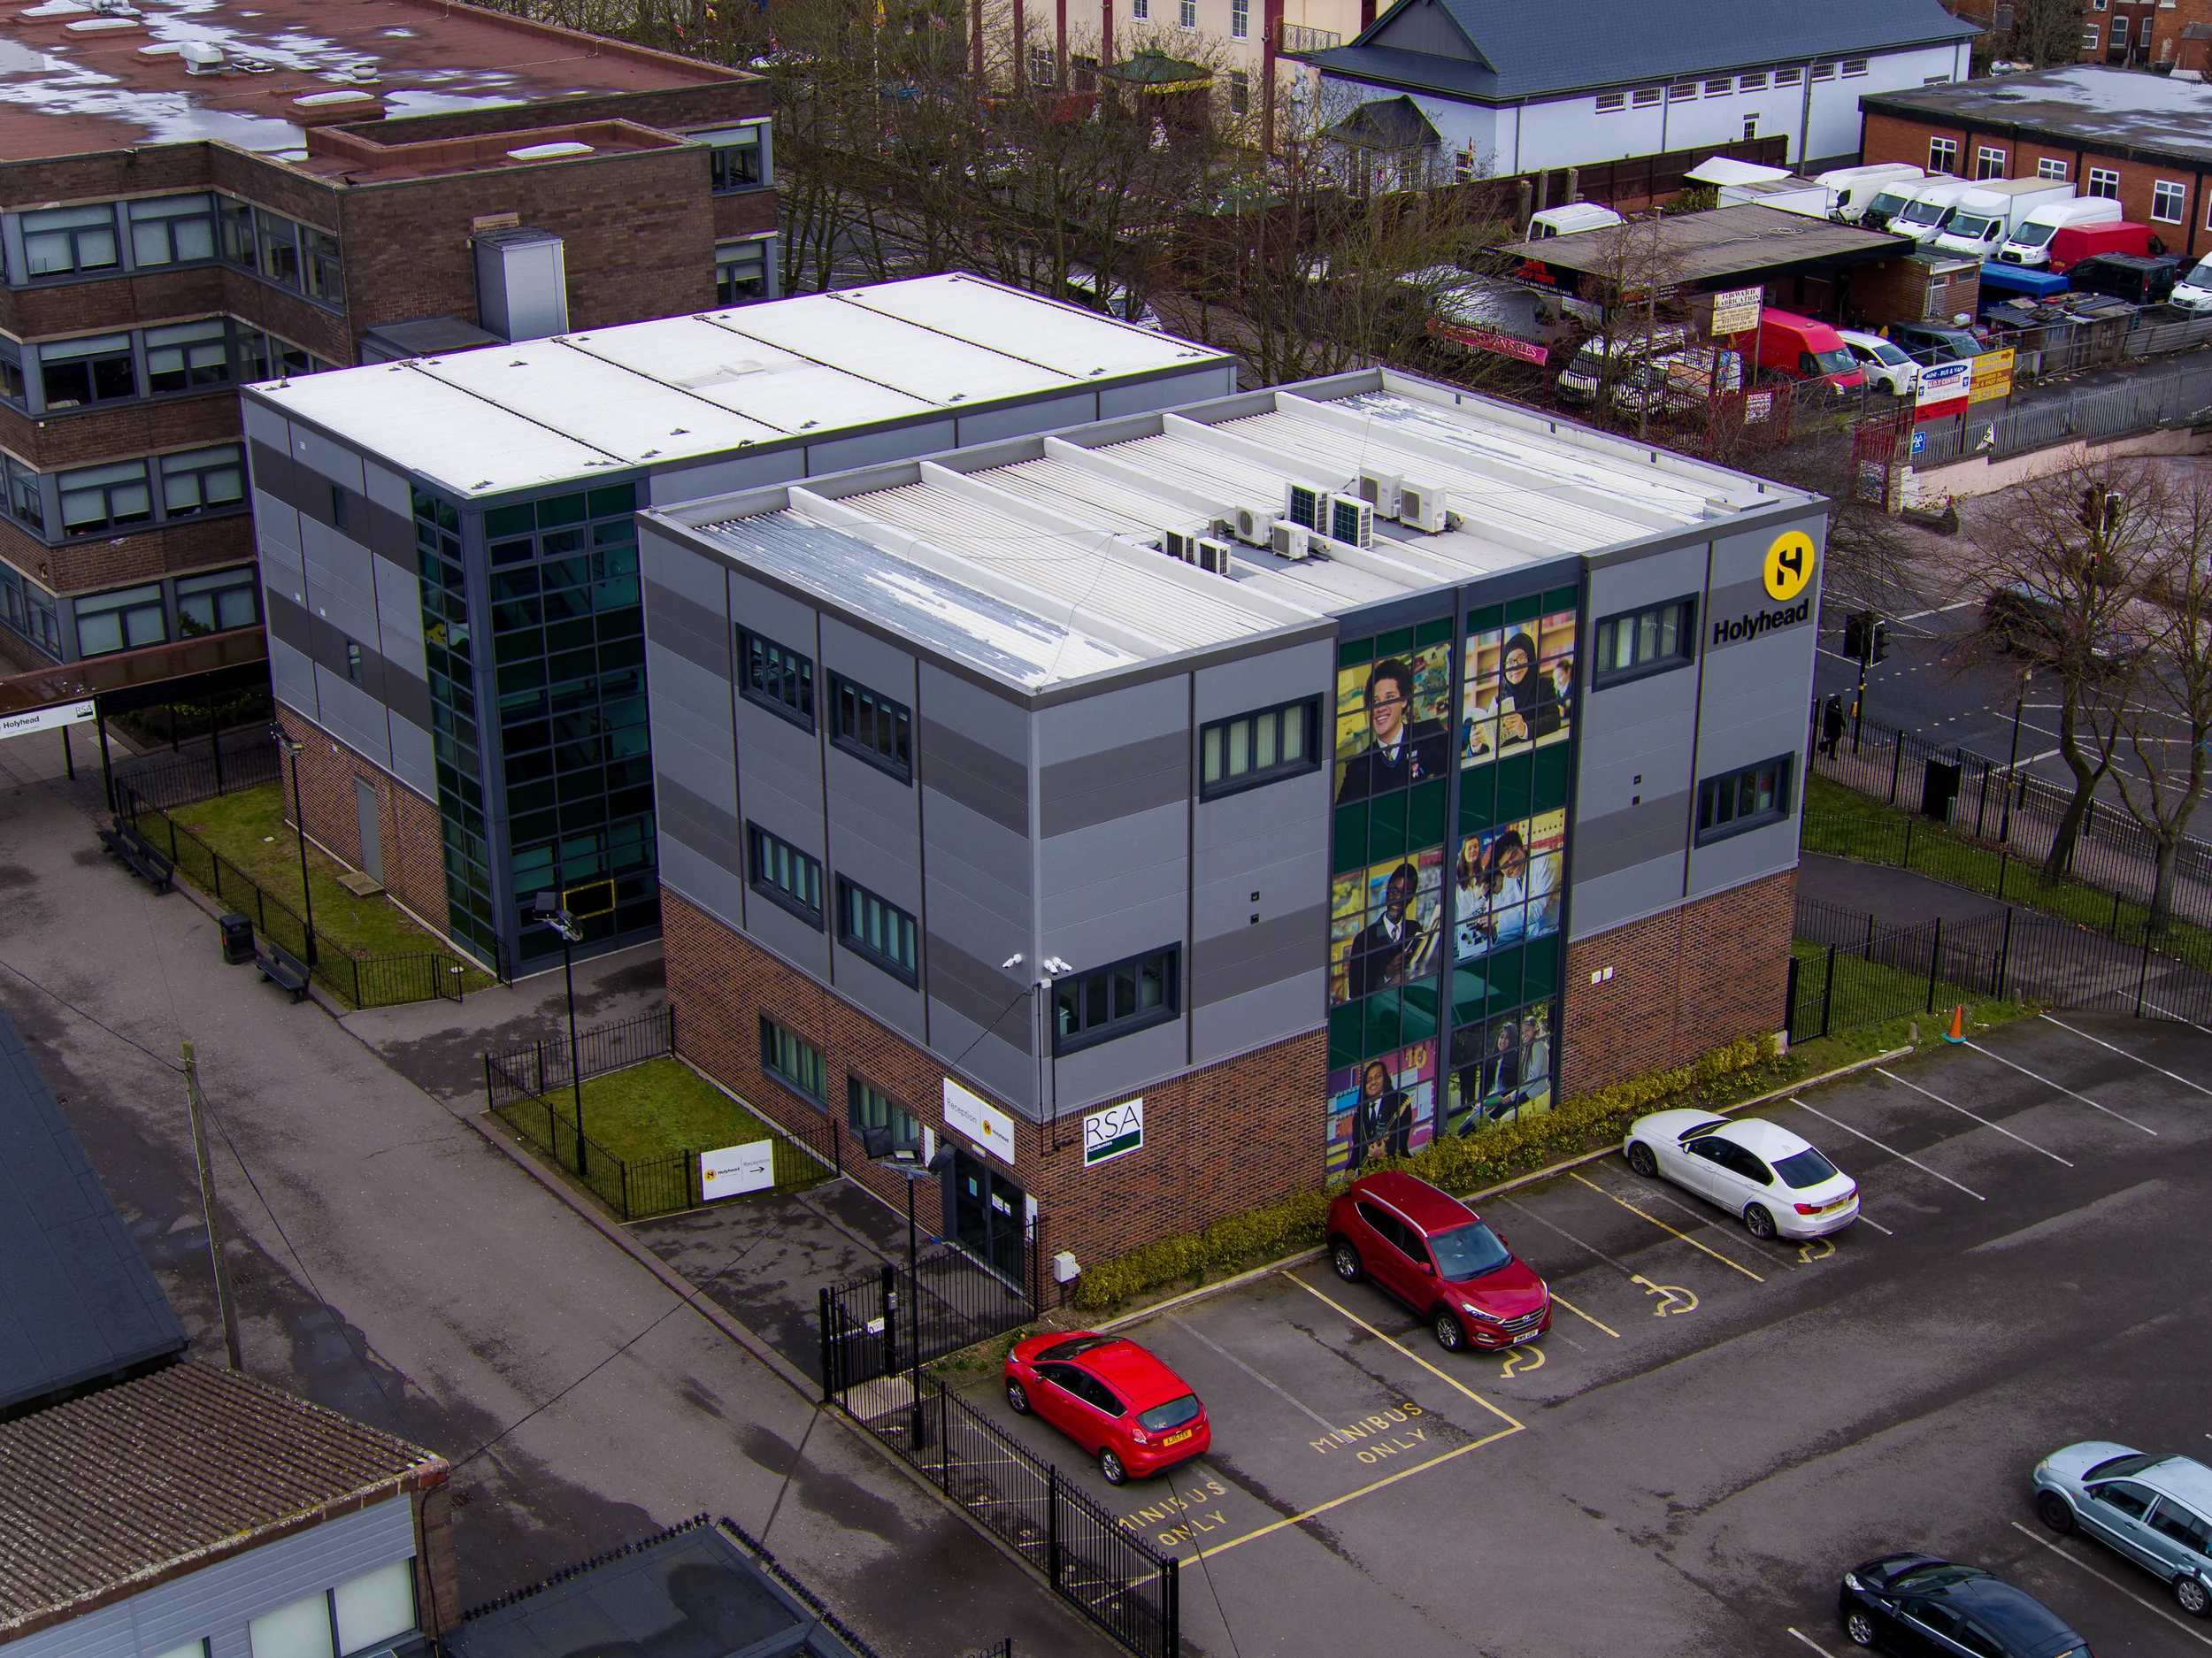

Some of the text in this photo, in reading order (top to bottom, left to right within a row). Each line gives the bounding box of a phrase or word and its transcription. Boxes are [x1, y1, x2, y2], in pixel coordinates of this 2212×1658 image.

[1717, 295, 1759, 306] FABRICATION
[1722, 289, 1755, 300] FORWARD
[1509, 342, 1537, 357] SALES
[1942, 376, 1959, 385] CENTRE
[1713, 598, 1810, 645] Holyhead
[76, 704, 93, 714] RSA
[4, 716, 40, 729] Holyhead
[947, 1097, 978, 1125] Reception
[1087, 1105, 1141, 1146] RSA
[1088, 1140, 1113, 1153] Academies
[743, 1157, 771, 1167] Reception
[1310, 1402, 1423, 1454] MINIBUS
[1356, 1428, 1427, 1463] ONLY
[1158, 1509, 1227, 1547] ONLY
